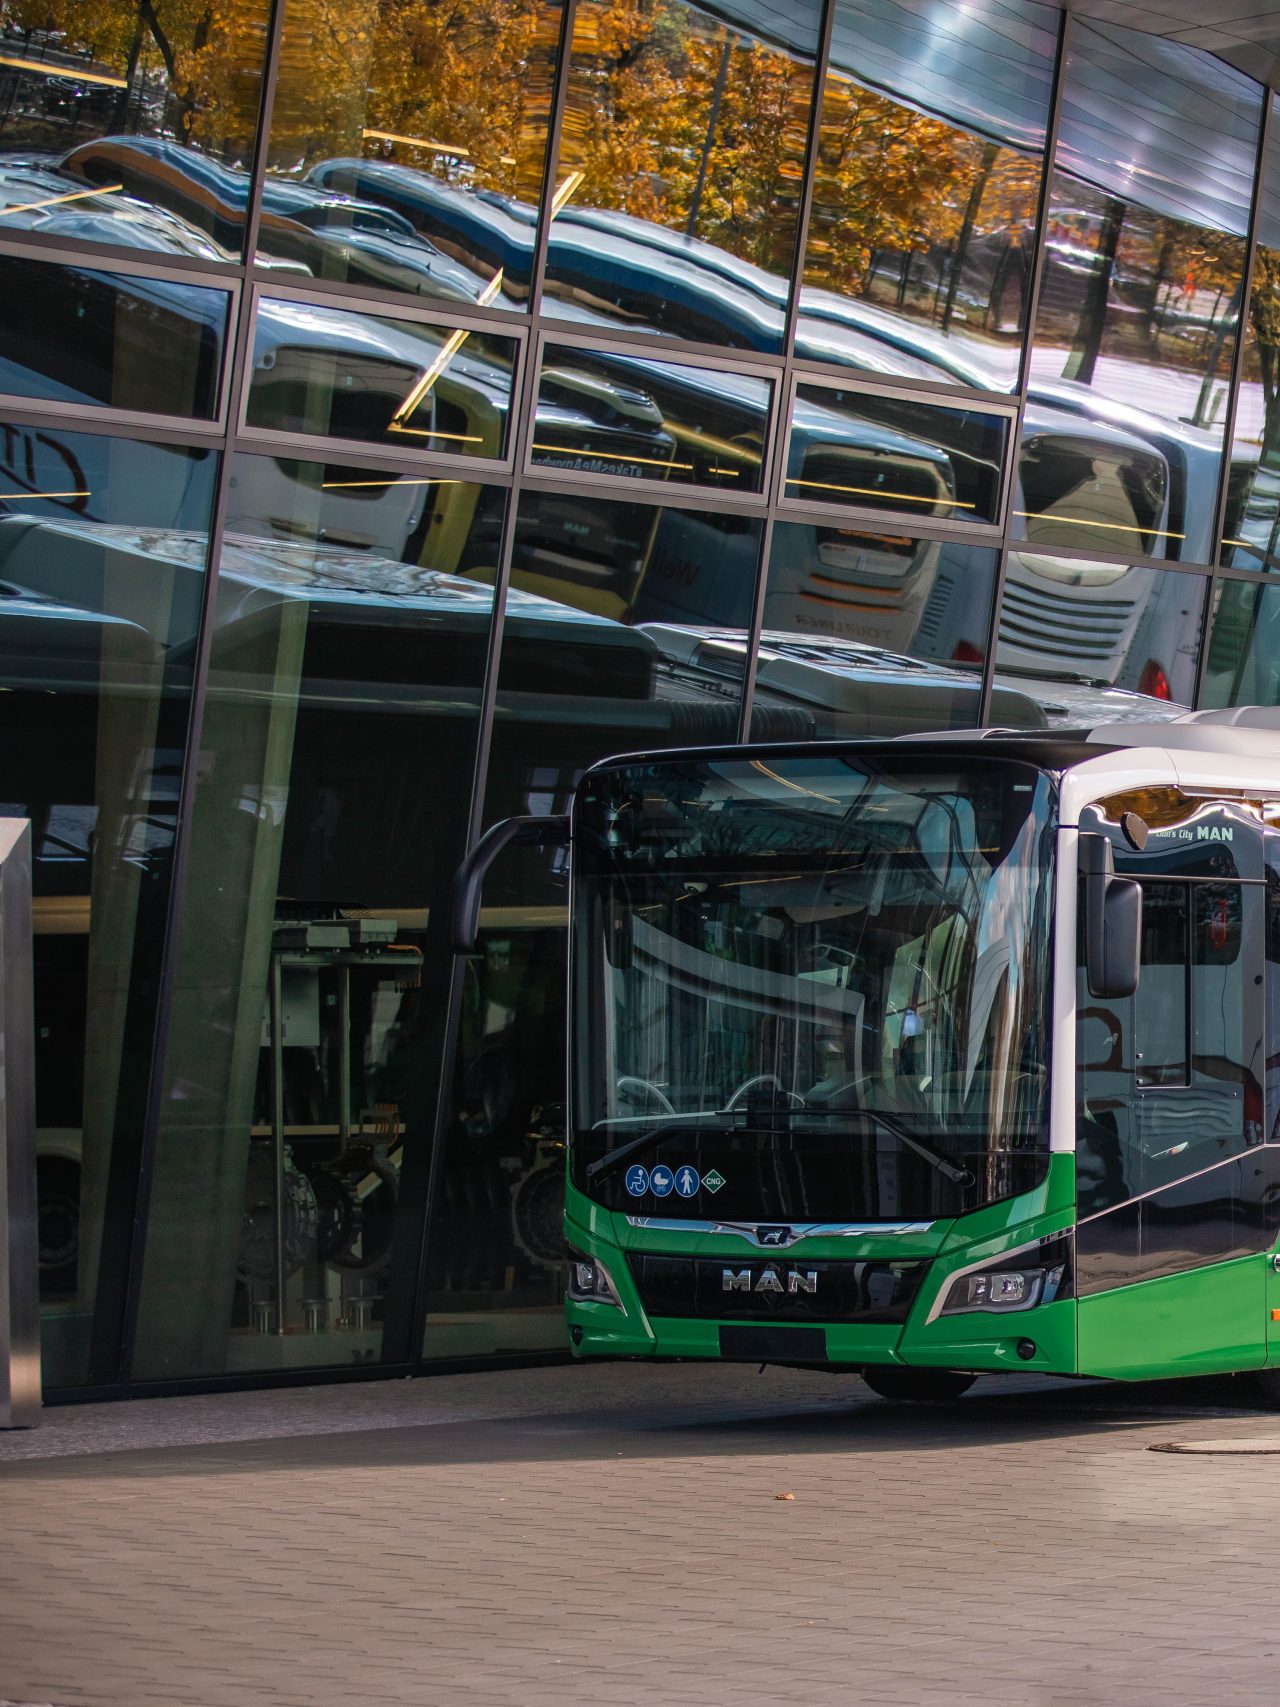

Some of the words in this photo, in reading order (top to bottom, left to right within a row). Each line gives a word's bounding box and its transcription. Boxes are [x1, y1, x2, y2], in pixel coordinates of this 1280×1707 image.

[1178, 829, 1193, 841] City
[1197, 826, 1233, 841] MAN
[706, 1177, 721, 1185] CNG
[722, 1269, 818, 1293] MAN
